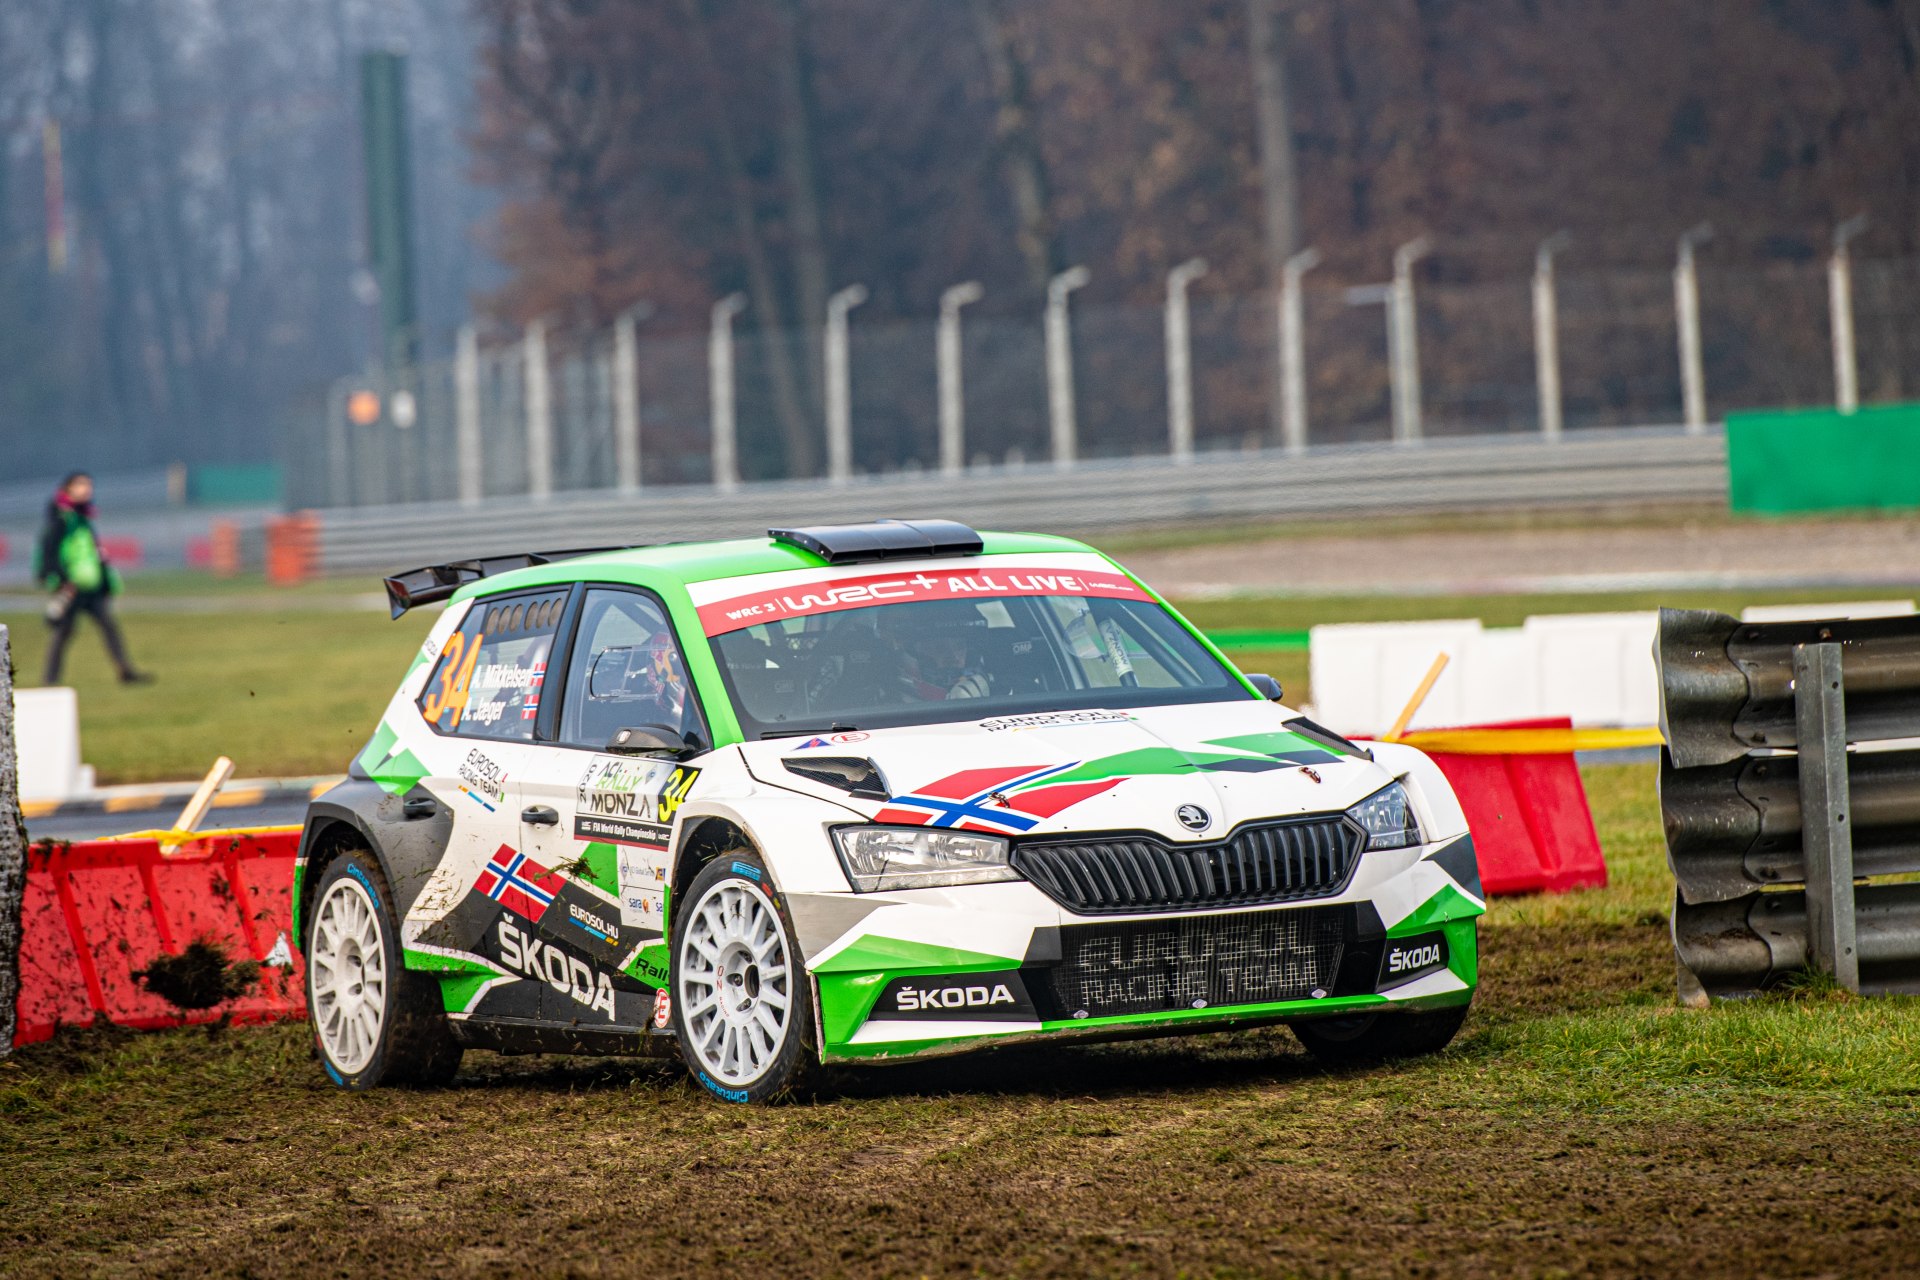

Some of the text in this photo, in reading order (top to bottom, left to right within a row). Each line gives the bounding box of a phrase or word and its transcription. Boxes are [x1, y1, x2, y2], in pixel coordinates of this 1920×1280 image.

[948, 575, 1009, 593] ALL
[1008, 575, 1083, 591] LIVE
[726, 602, 777, 621] WRC 3
[422, 630, 484, 727] 34
[482, 664, 534, 688] Mikkelsen
[979, 711, 1117, 728] EUROSOL
[987, 715, 1121, 732] RACING TEAM
[466, 747, 501, 785] EUROSOL
[457, 763, 500, 800] RACING TEAM
[658, 768, 699, 822] 34
[589, 793, 651, 819] MONZA
[1078, 920, 1316, 973] EUROSOL
[1389, 944, 1441, 973] ŠKODA
[498, 912, 616, 1022] ŠKODA
[1079, 957, 1318, 1006] RACING TEAM
[896, 984, 1016, 1011] ŠKODA
[699, 1071, 749, 1103] Cinturato
